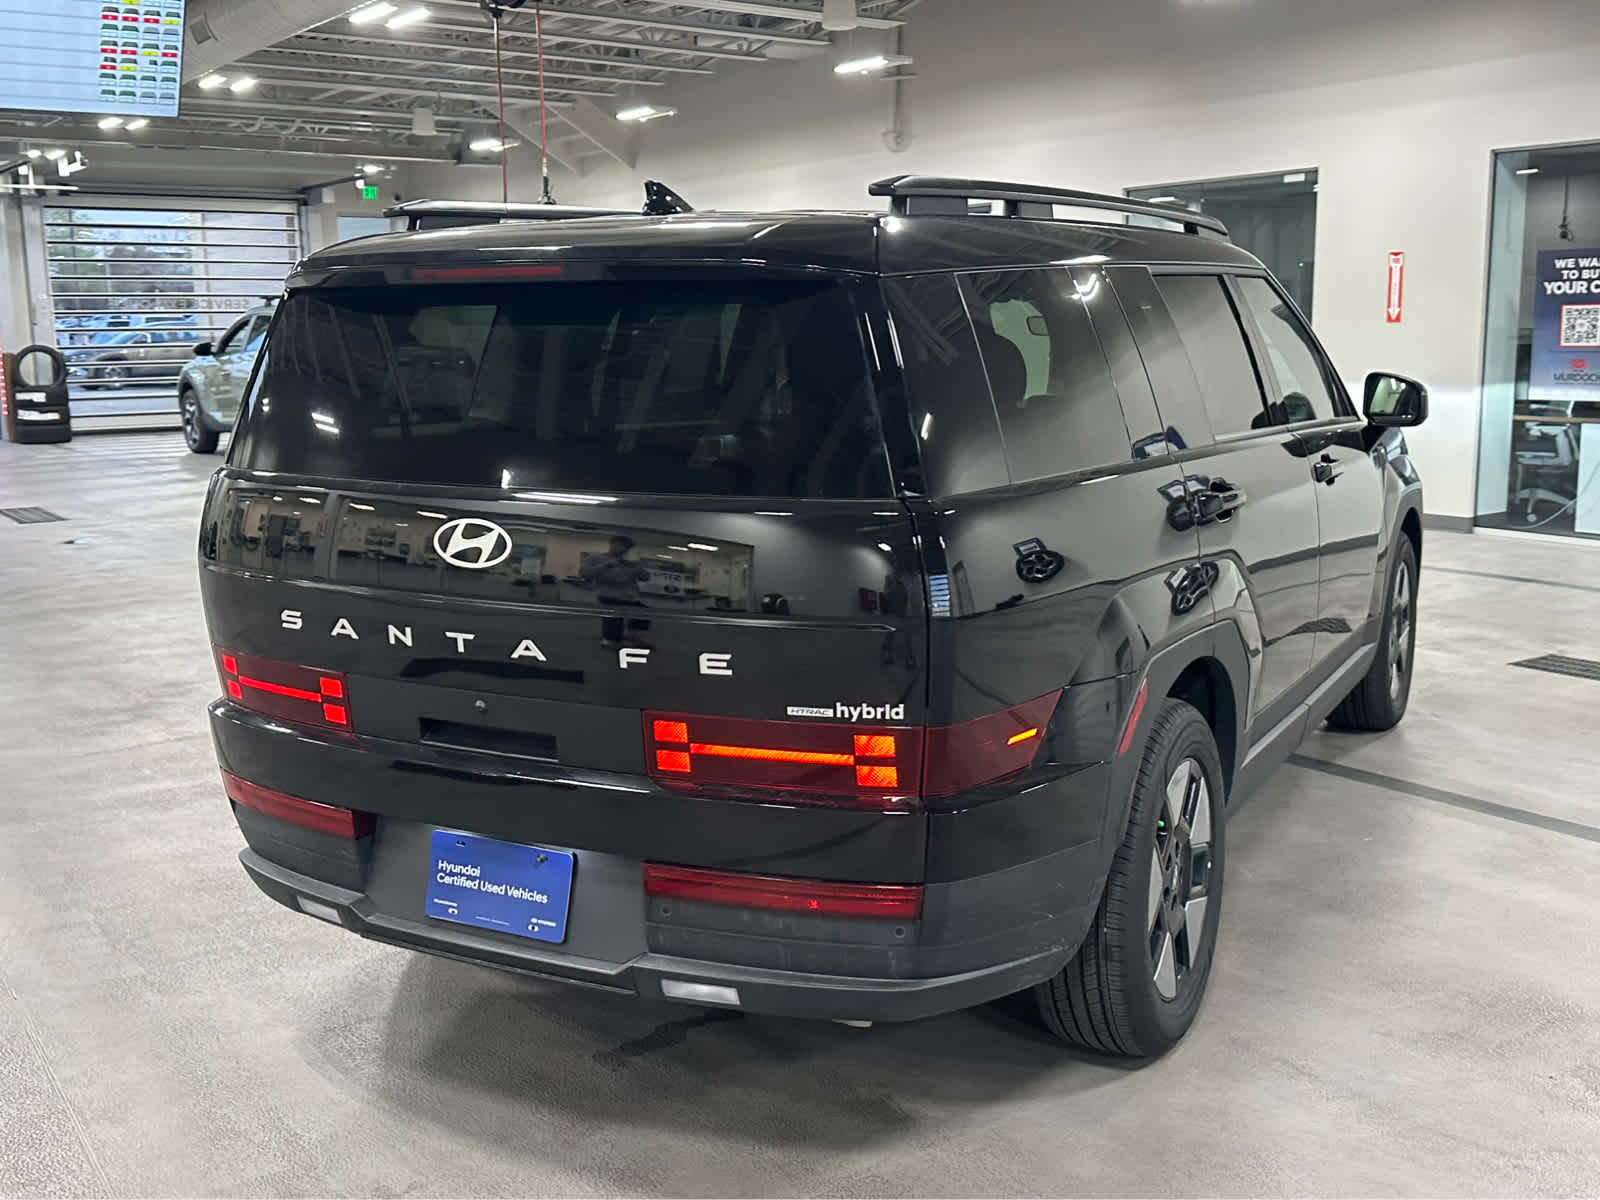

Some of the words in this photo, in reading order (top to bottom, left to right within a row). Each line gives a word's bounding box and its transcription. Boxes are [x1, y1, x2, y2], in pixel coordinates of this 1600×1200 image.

[1554, 258, 1576, 269] WE
[1561, 270, 1579, 280] TO
[1543, 281, 1588, 295] YOUR
[281, 609, 547, 662] SANTA
[618, 648, 733, 676] FE
[835, 702, 905, 722] hybrid
[437, 859, 480, 877] Hyundai
[436, 872, 479, 890] Certified
[480, 880, 505, 896] Used
[507, 884, 548, 904] Vehicles
